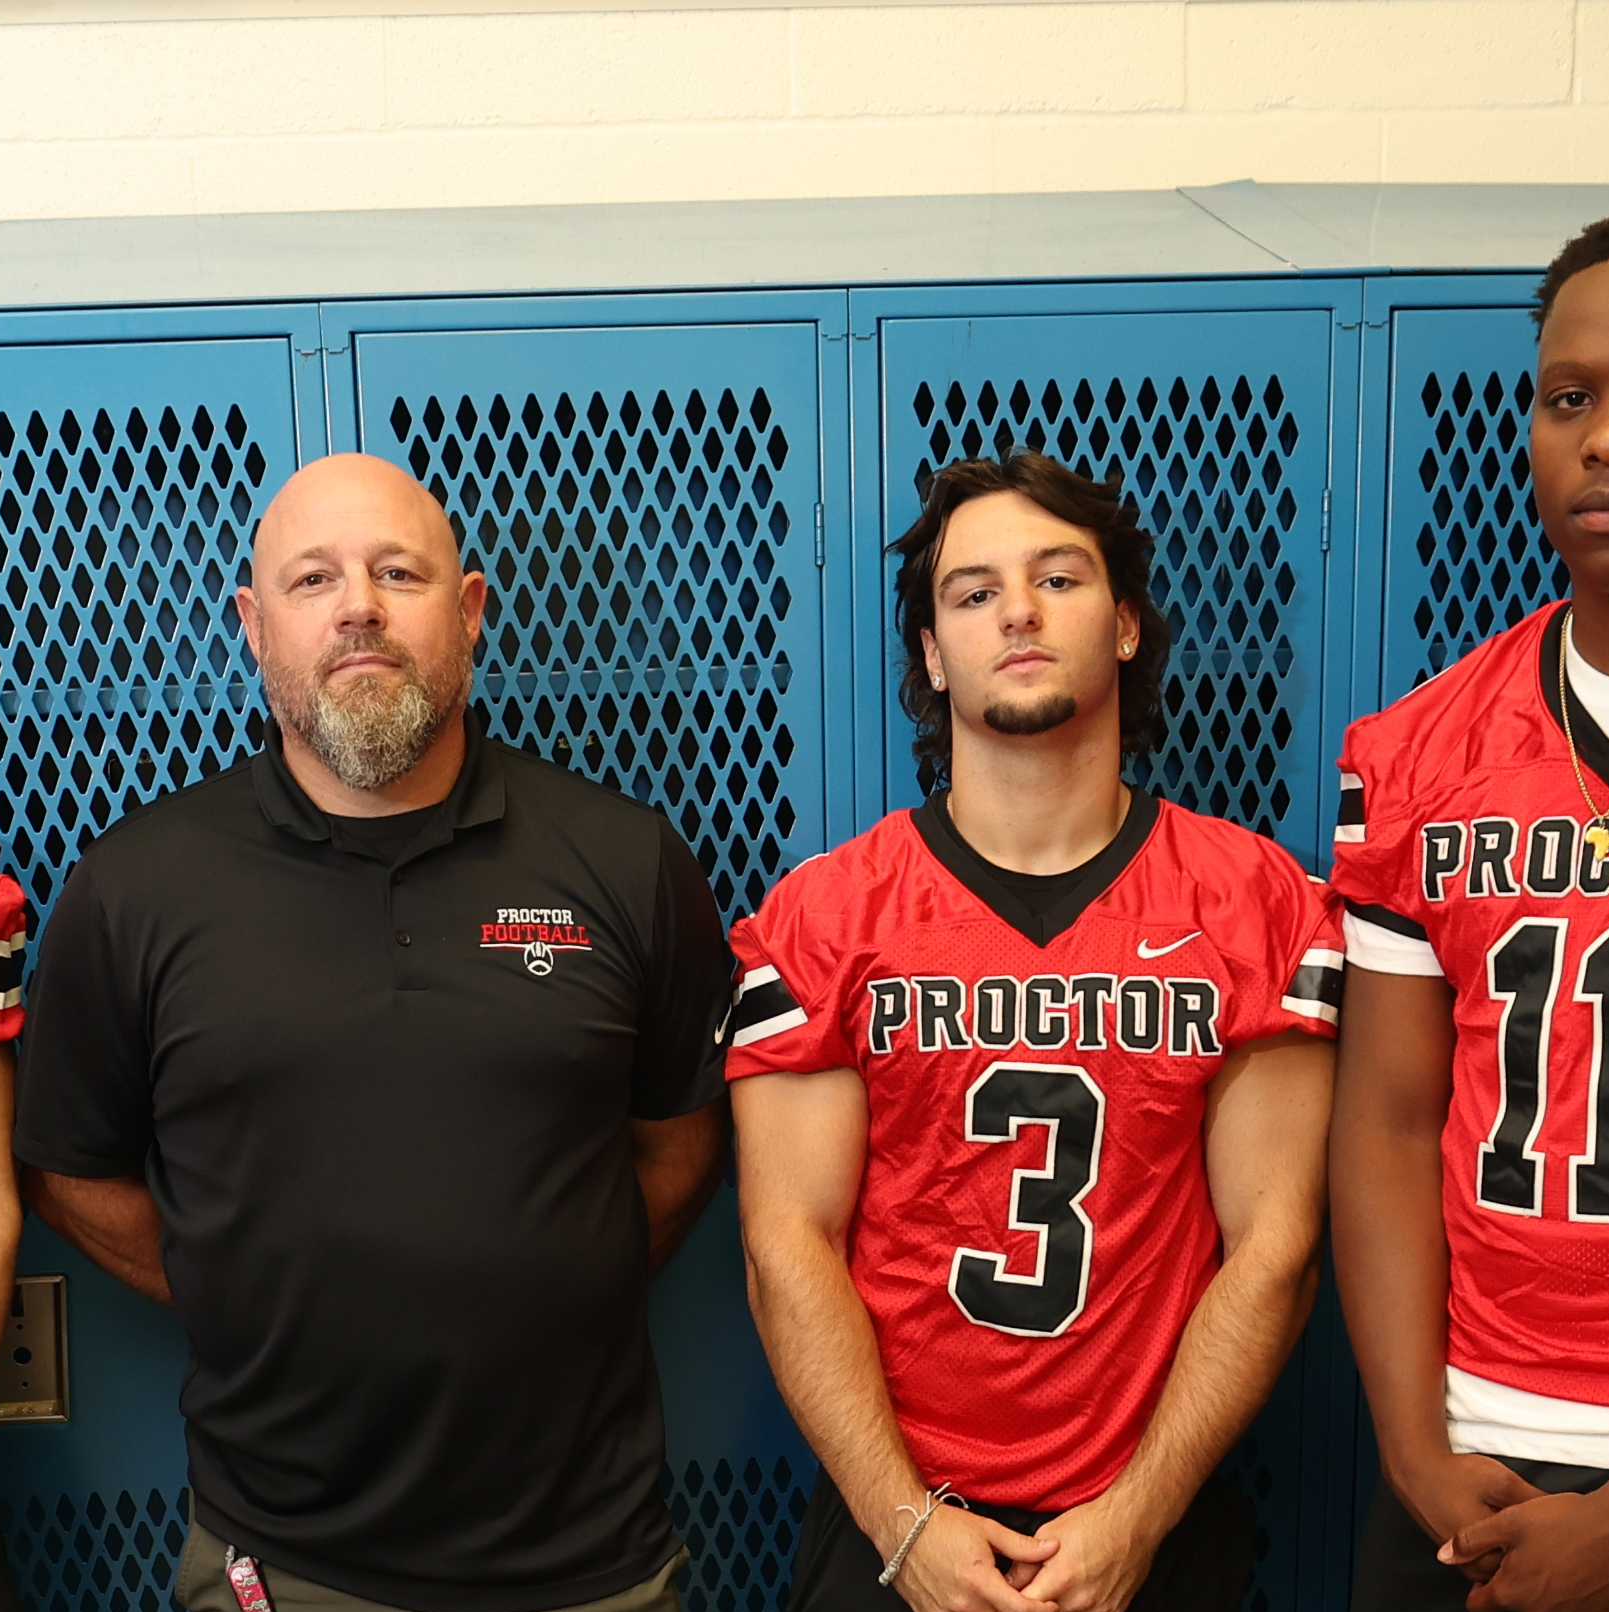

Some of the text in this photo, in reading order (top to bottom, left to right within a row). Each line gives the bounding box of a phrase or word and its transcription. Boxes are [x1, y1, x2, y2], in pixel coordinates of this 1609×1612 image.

[480, 924, 590, 945] FOOTBALL
[497, 908, 574, 925] PROCTOR
[868, 973, 1224, 1057] PROCTOR
[947, 1061, 1106, 1338] 3
